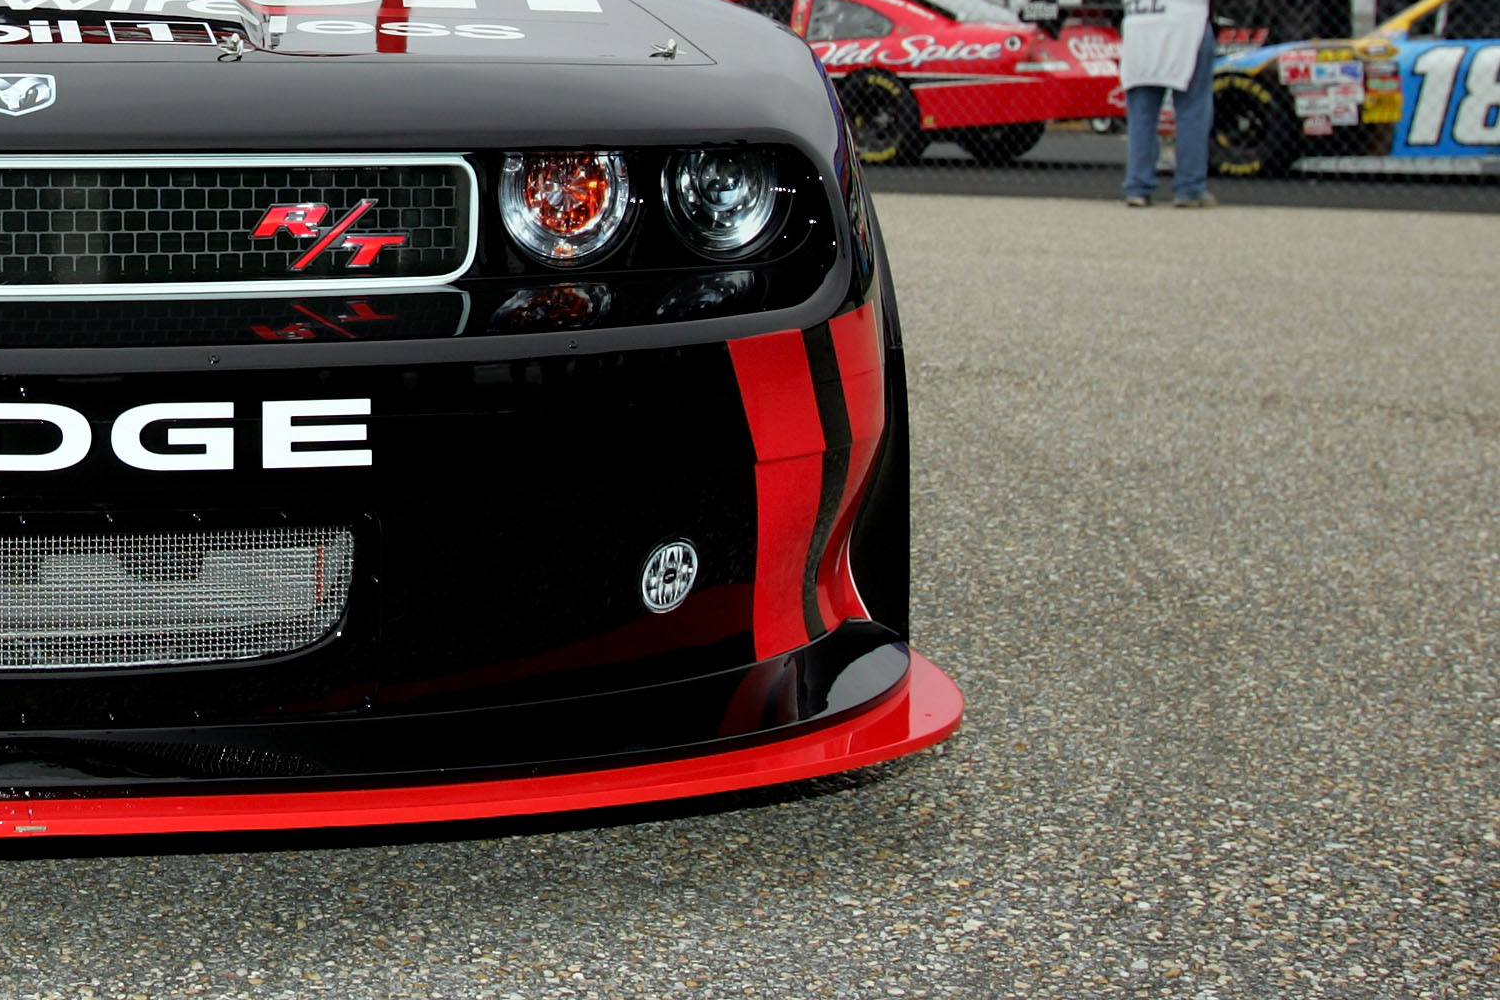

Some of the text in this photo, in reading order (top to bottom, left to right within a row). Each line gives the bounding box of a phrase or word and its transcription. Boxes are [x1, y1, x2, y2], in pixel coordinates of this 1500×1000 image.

[136, 22, 175, 43] 1
[877, 34, 1001, 68] Spice
[1406, 45, 1500, 146] 18
[248, 198, 411, 272] R/T
